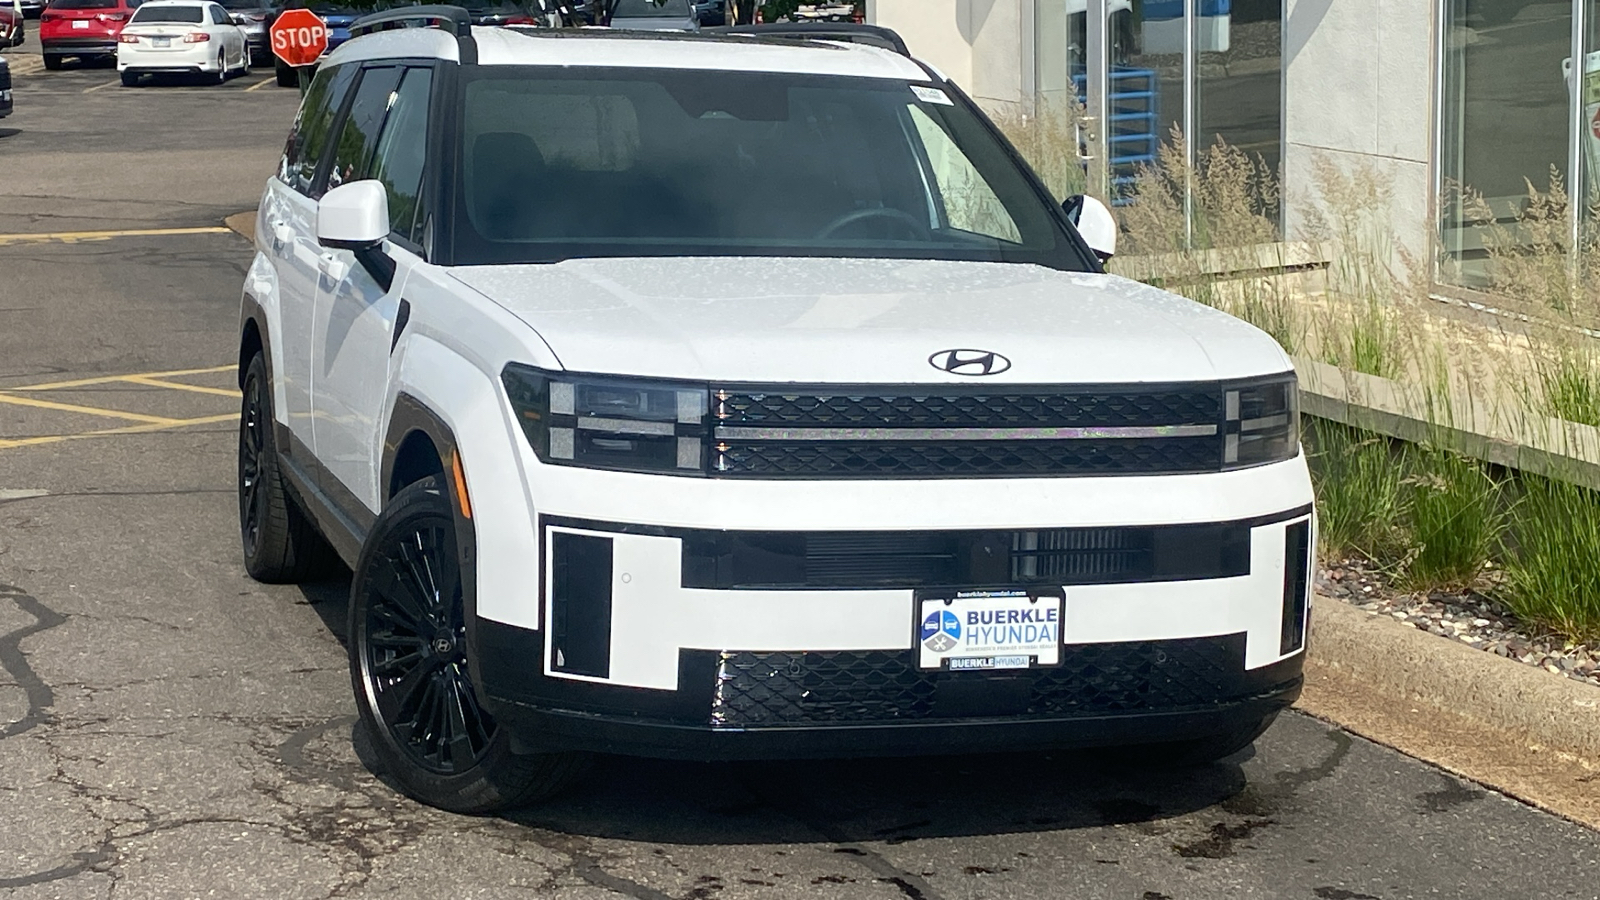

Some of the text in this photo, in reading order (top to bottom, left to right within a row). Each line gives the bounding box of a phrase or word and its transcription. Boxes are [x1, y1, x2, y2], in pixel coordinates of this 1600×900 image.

[275, 26, 323, 49] STOP
[966, 608, 1057, 625] BUERKLE
[966, 624, 1057, 645] HYUNDAI
[951, 657, 1028, 668] BUERKLE HYUNDAI
